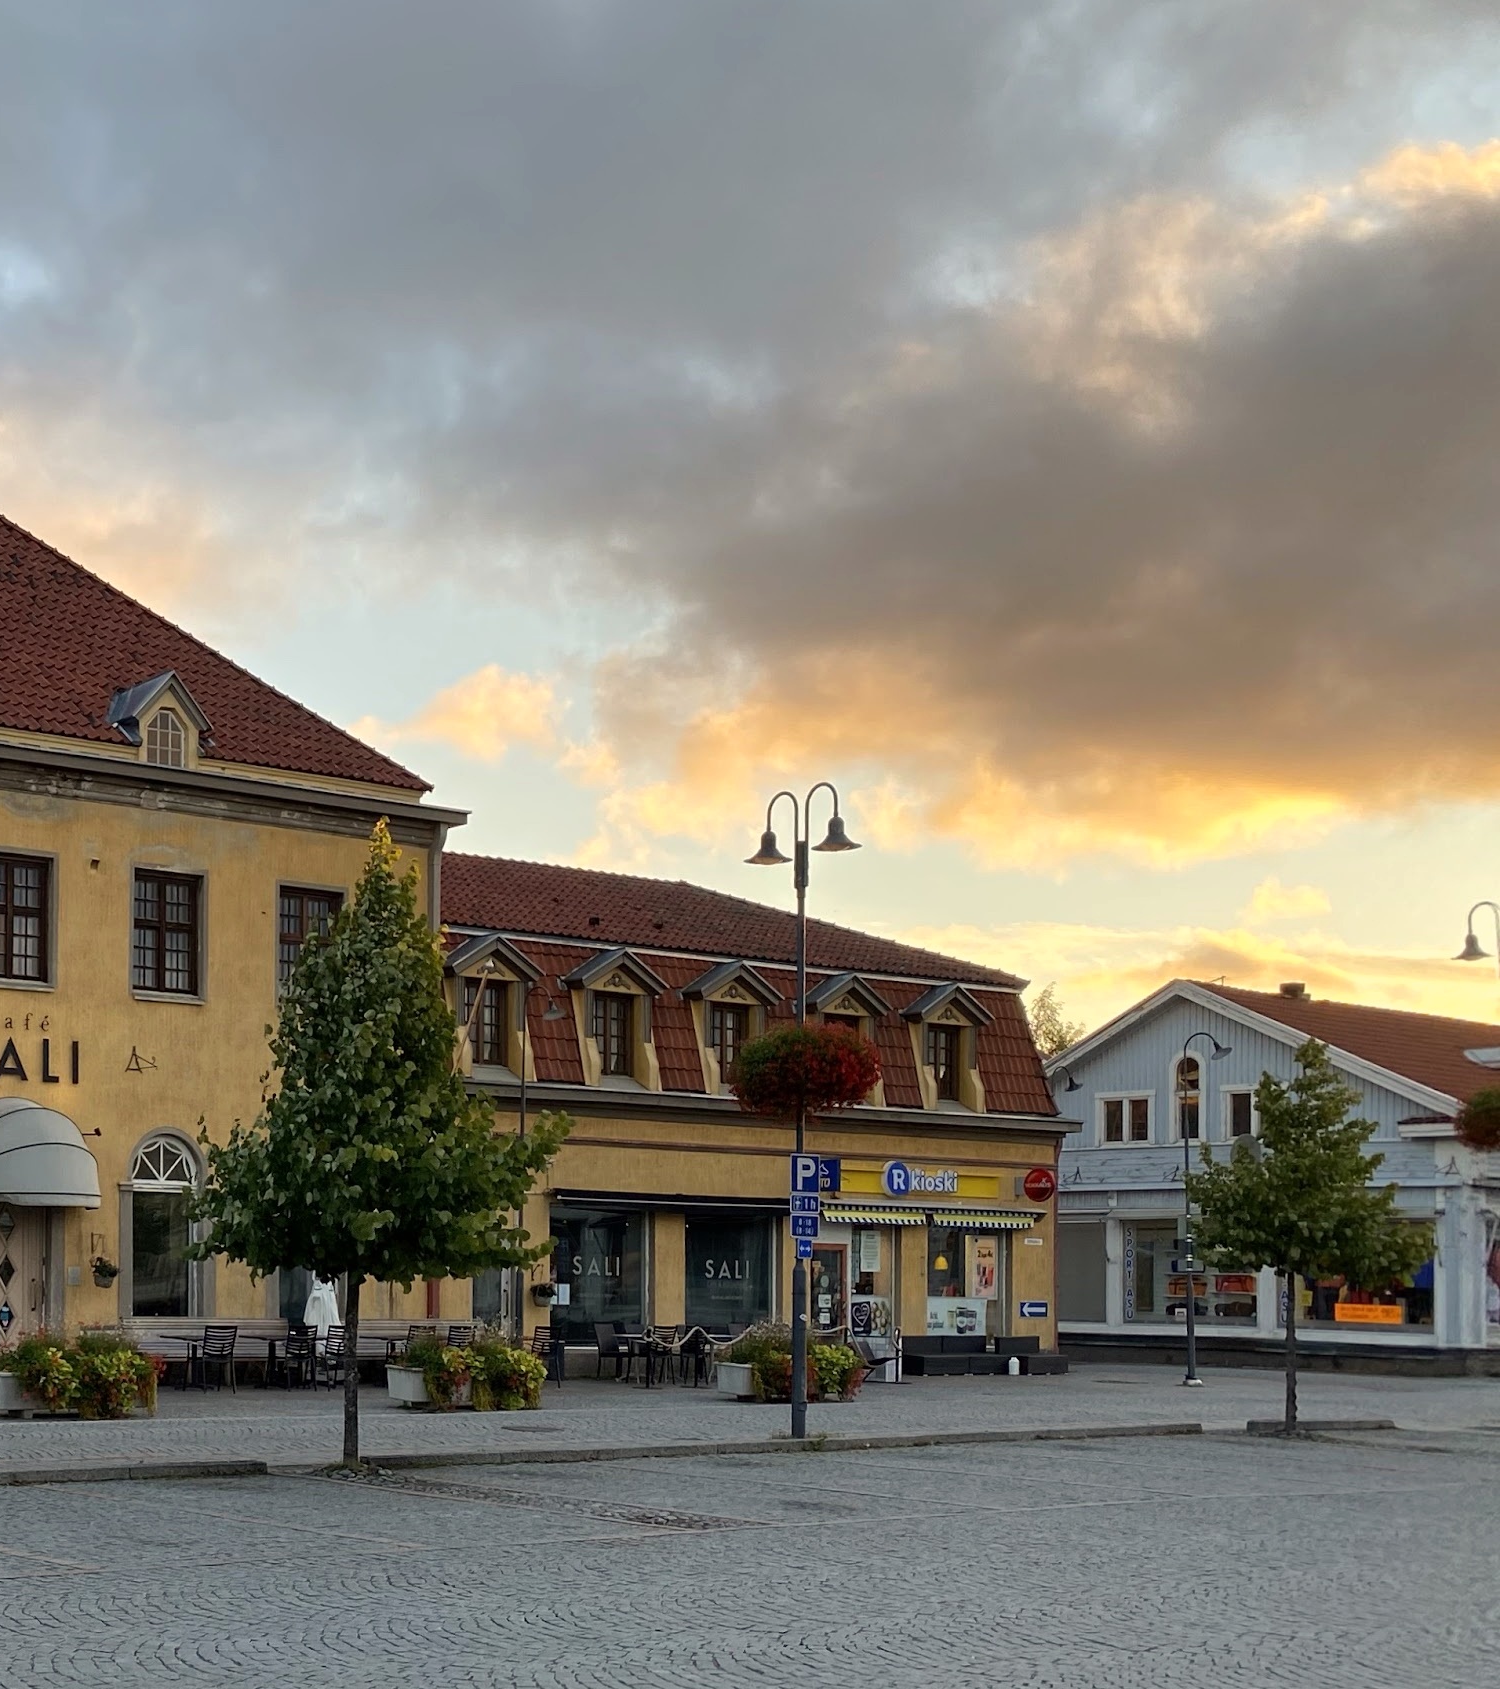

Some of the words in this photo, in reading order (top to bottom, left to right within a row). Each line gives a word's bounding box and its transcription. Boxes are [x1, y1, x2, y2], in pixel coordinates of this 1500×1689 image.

[797, 1157, 816, 1191] P
[911, 1170, 958, 1192] kioski
[572, 1255, 620, 1277] SALI
[705, 1259, 750, 1279] SALI
